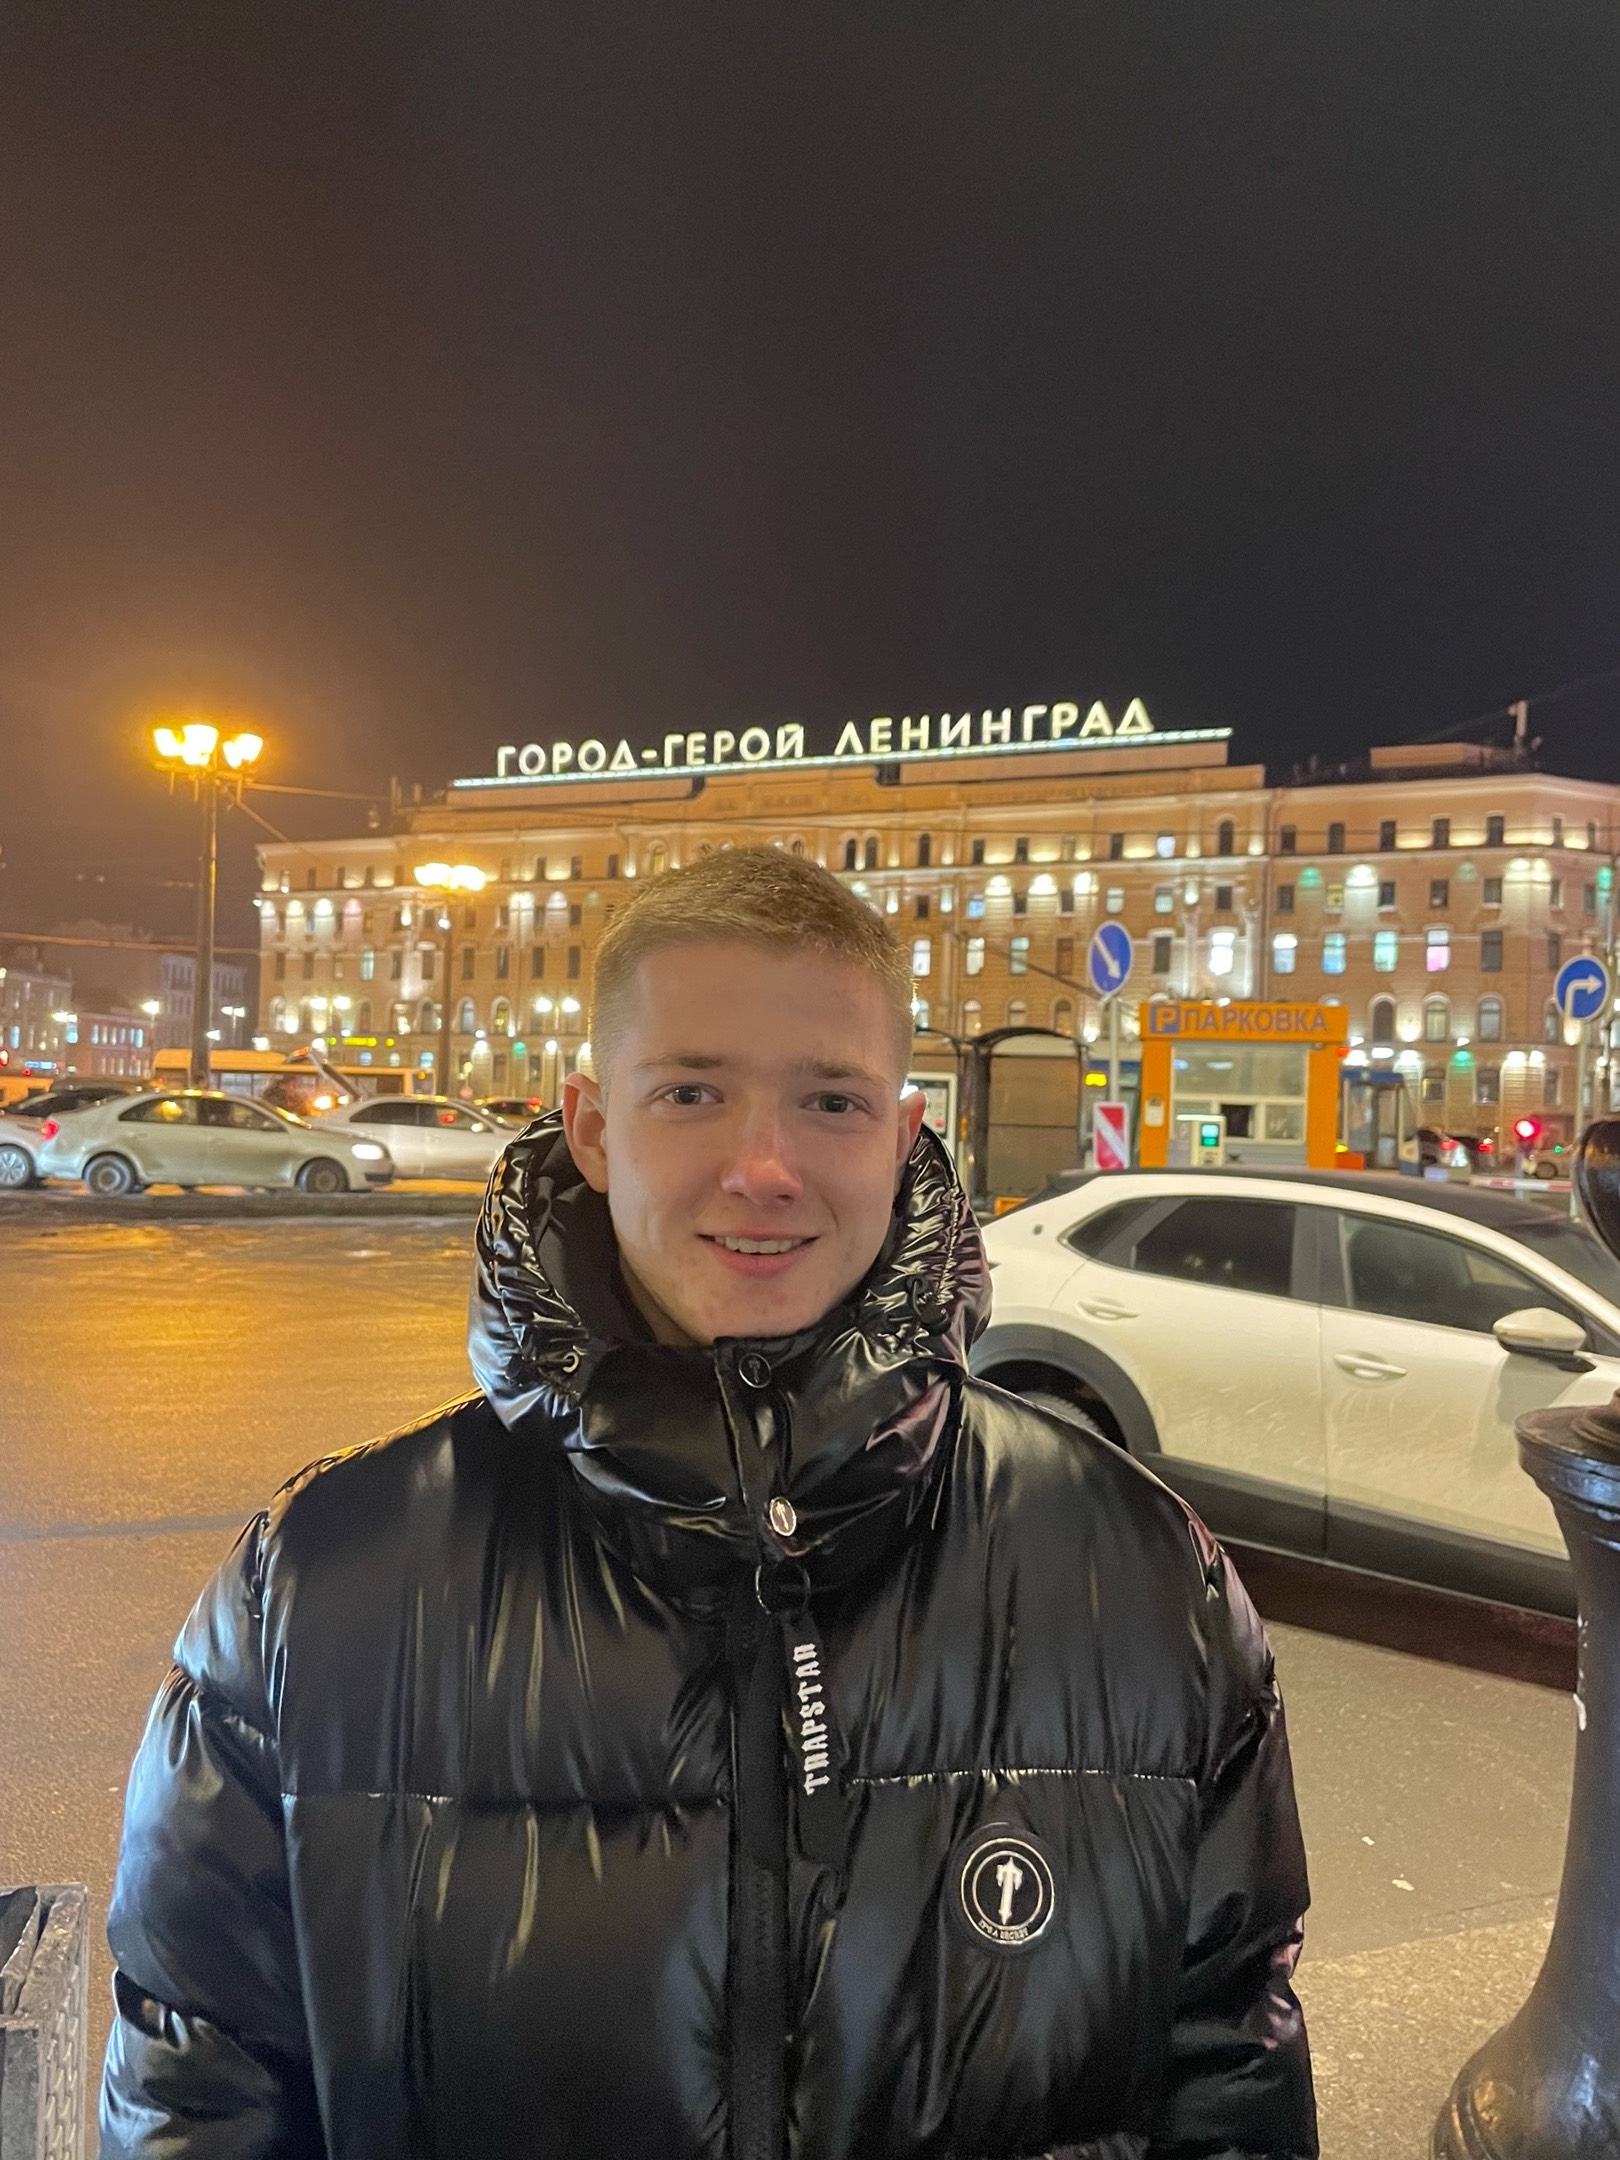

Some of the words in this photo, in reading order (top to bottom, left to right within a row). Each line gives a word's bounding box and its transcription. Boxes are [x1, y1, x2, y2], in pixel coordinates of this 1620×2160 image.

[497, 723, 804, 777] ГОРОД-ГЕРОЙ
[834, 697, 1154, 755] ЛЕНИНГРАД
[1183, 1008, 1328, 1034] ПАРКОВКА
[793, 1643, 830, 1796] TRAPSTAR
